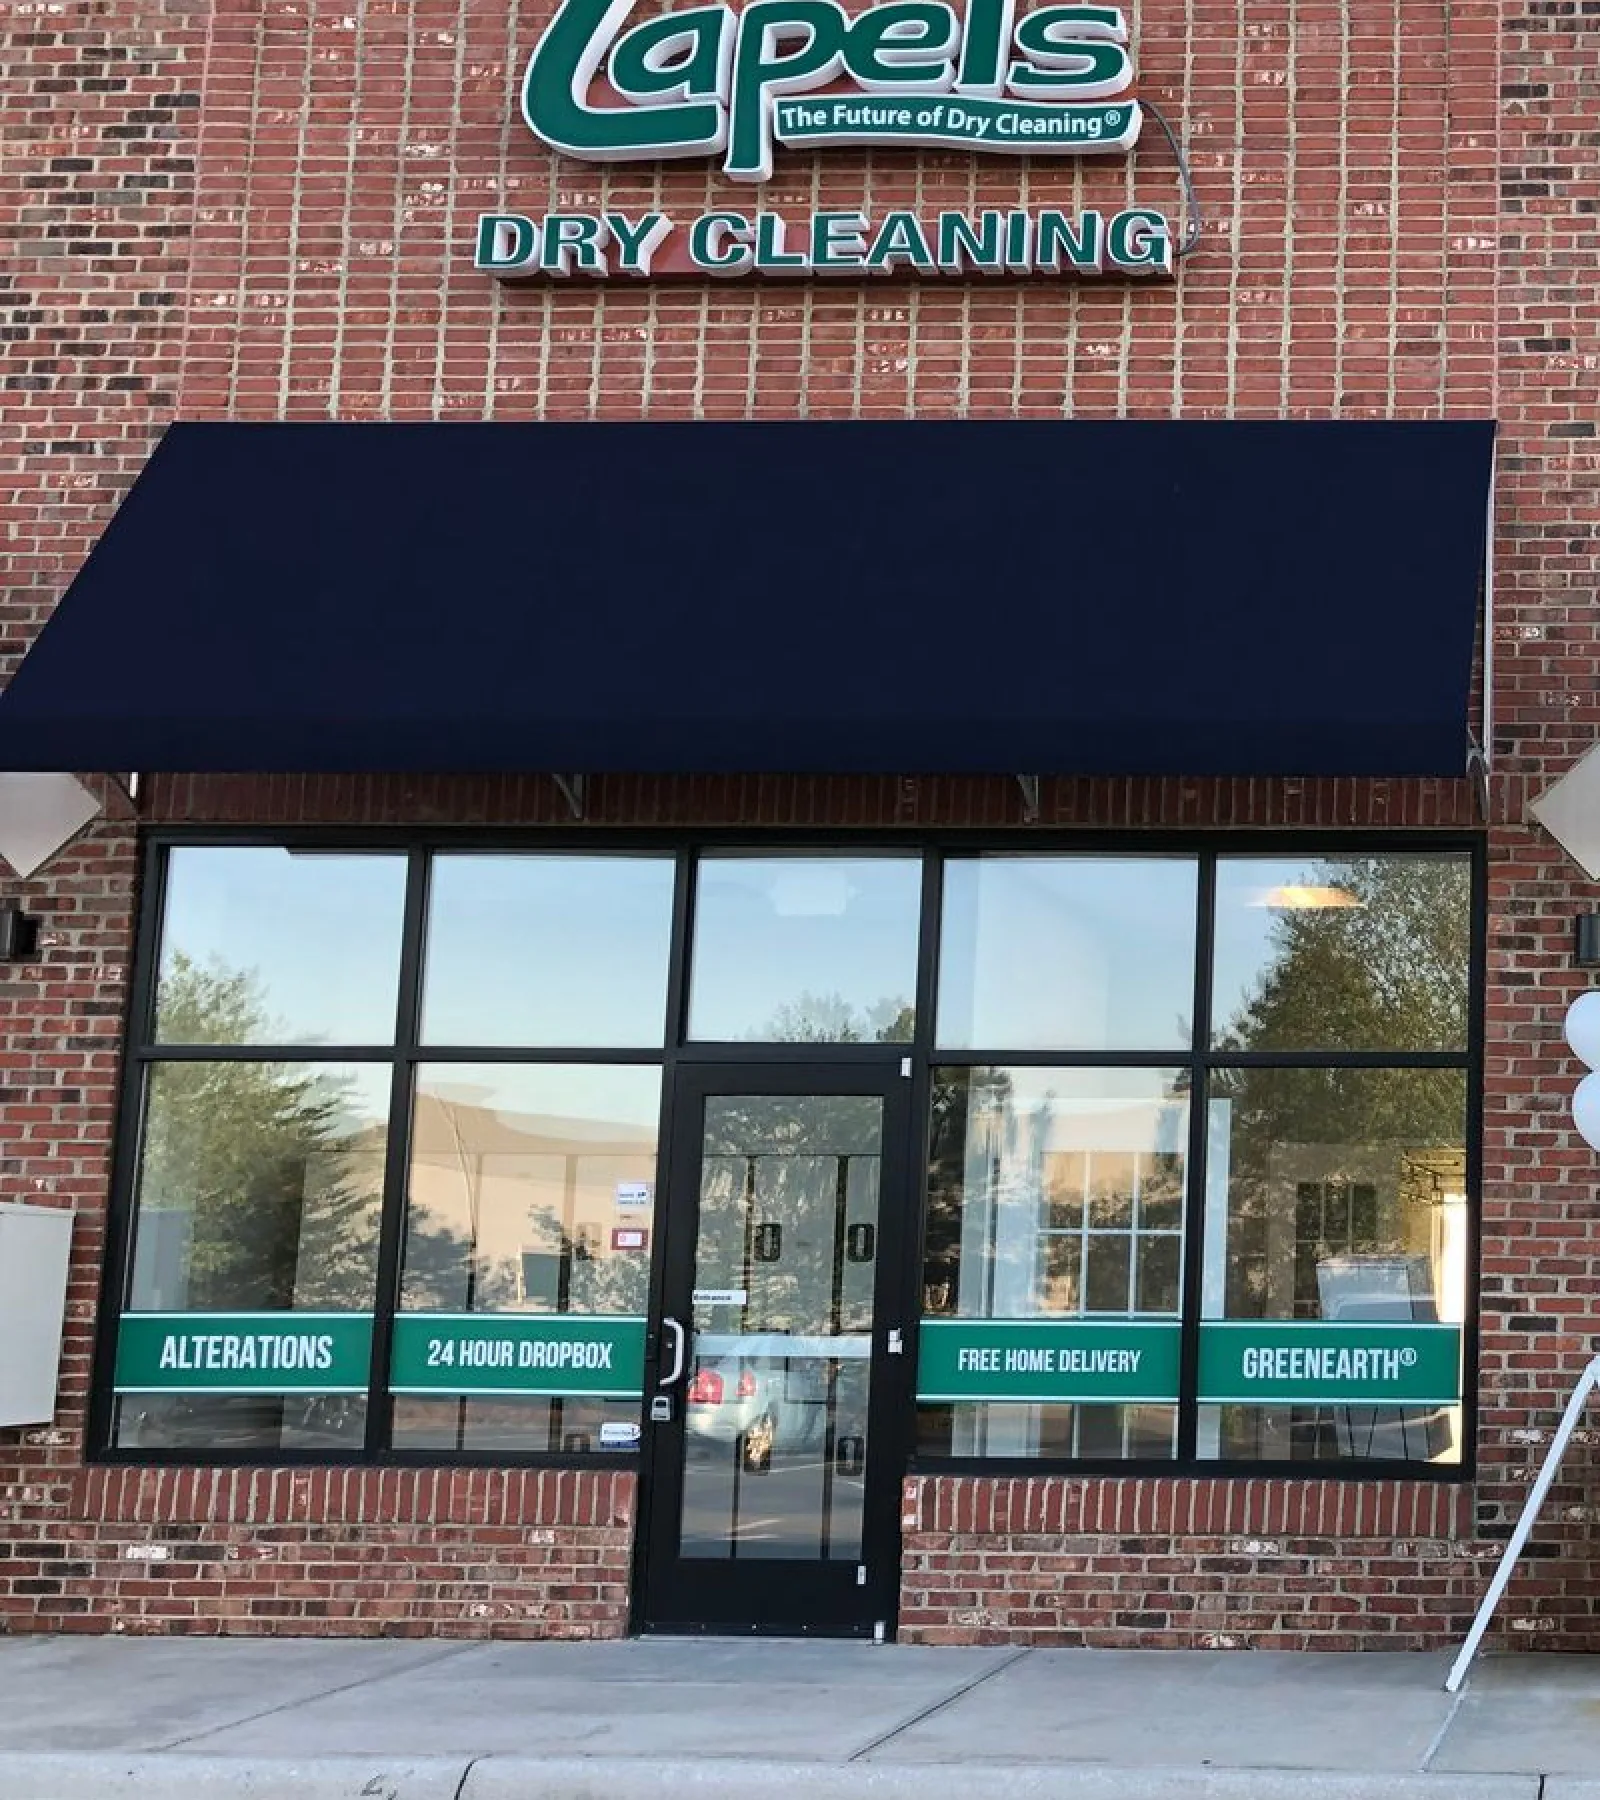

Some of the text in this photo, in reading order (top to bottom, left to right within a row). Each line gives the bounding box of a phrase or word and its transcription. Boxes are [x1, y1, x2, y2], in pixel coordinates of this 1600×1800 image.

[522, 0, 1136, 180] Lapels
[780, 106, 827, 129] The
[833, 104, 911, 127] Future
[917, 104, 944, 127] of
[947, 107, 991, 138] Dry
[474, 211, 1174, 277] DRY CLEANING
[159, 1334, 333, 1369] ALTERATIONS
[427, 1338, 613, 1369] 24 HOUR DROPBOX
[958, 1348, 1141, 1374] FREE HOME DELIVERY
